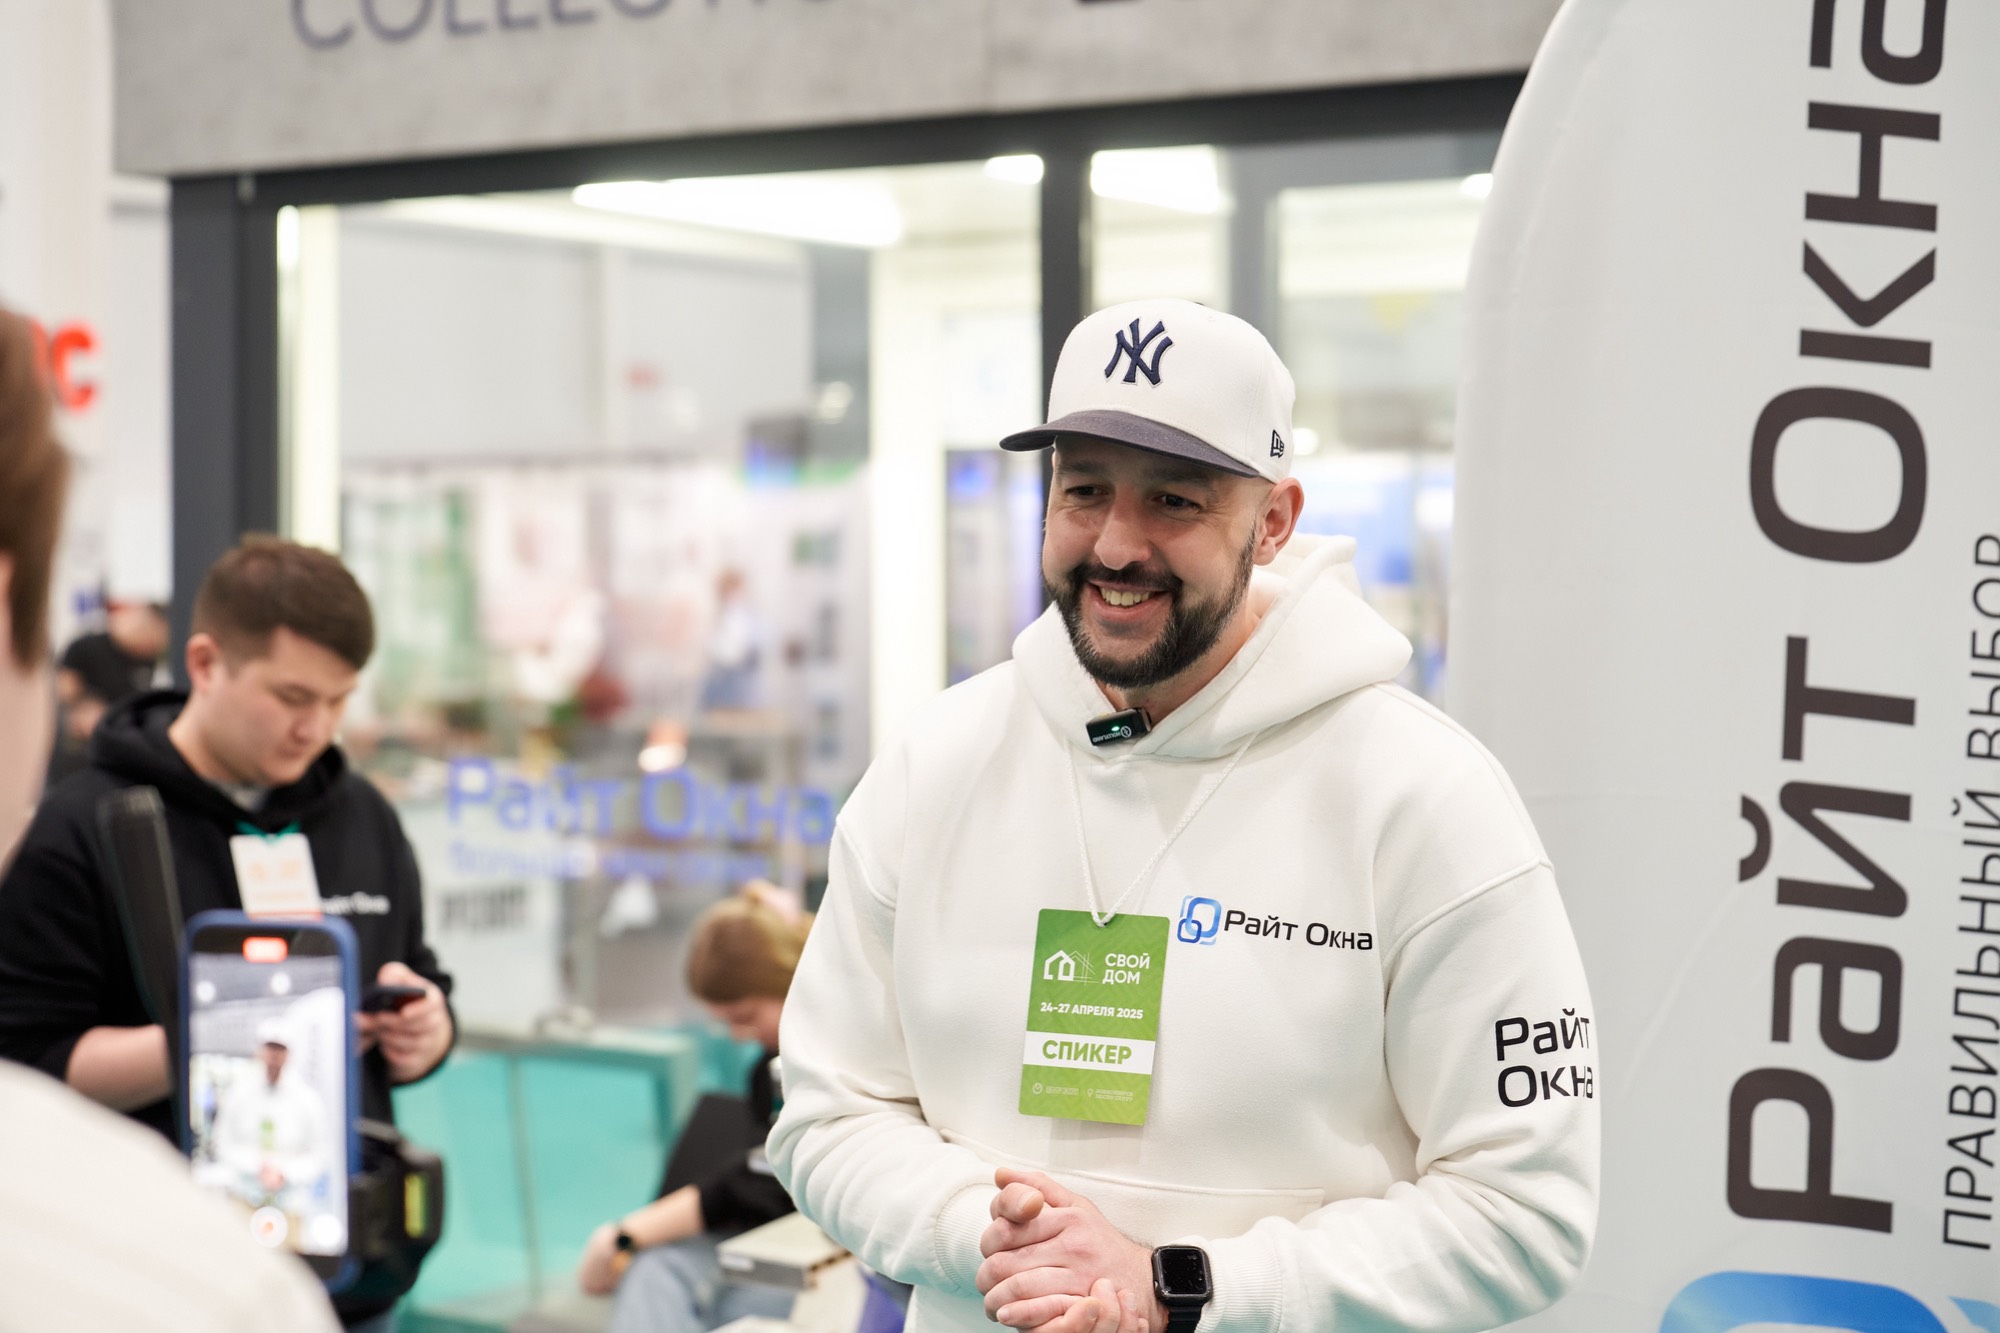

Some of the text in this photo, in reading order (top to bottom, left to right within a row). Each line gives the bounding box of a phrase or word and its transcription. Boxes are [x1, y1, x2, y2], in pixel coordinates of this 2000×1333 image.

[1726, 0, 1948, 1234] Райт Окна
[1223, 909, 1373, 951] Райт Окна
[1102, 969, 1141, 985] ДОМ
[1105, 952, 1151, 970] СВОЙ
[1072, 1004, 1115, 1017] АПРЕЛЯ
[1116, 1008, 1144, 1020] 2025
[1942, 788, 2000, 1250] ПРАВИЛЬНЫЙ
[1042, 1039, 1132, 1065] СПИКЕР
[1495, 1007, 1590, 1061] Райт
[1498, 1065, 1593, 1108] Окна
